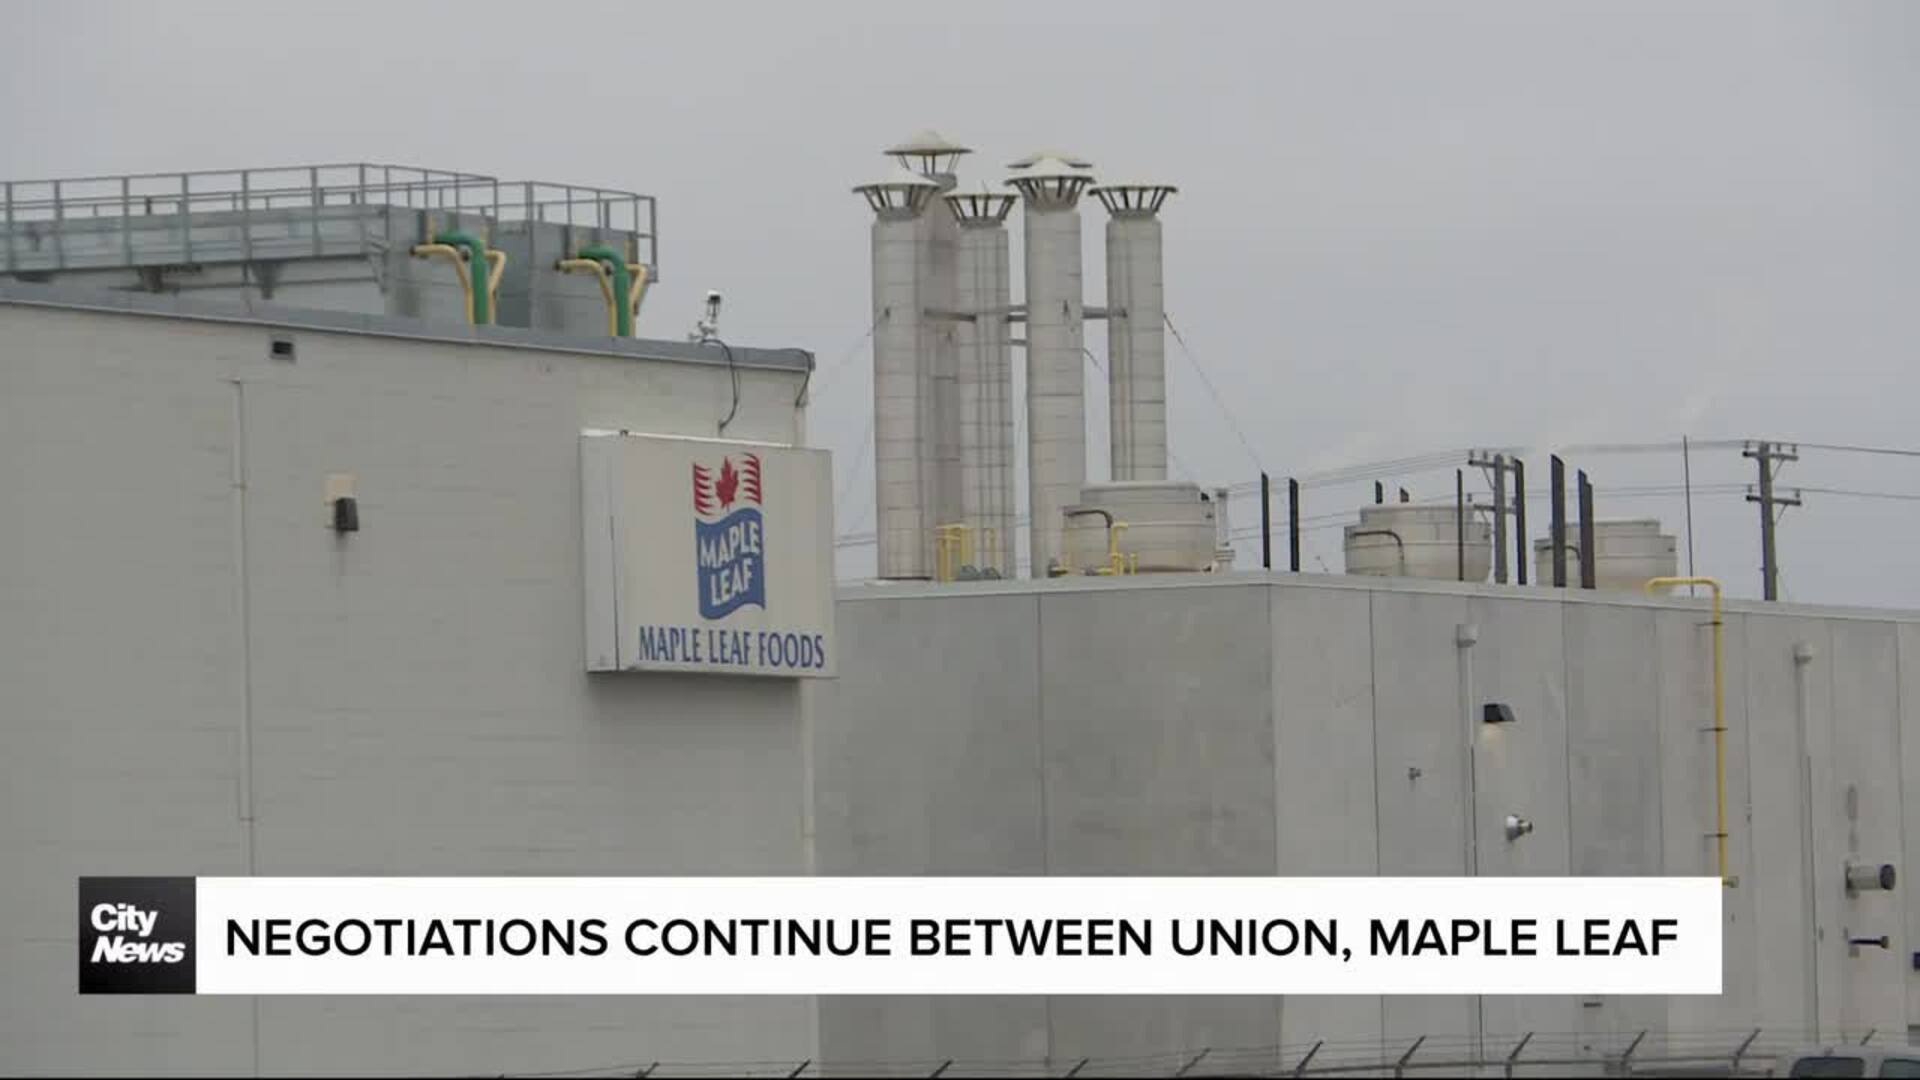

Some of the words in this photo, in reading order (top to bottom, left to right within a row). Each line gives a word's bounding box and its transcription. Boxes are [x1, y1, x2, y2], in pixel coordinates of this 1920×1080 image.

[700, 521, 760, 568] MAPLE
[711, 558, 753, 606] LEAF
[639, 626, 703, 662] MAPLE
[709, 629, 752, 665] LEAF
[758, 632, 825, 668] FOODS
